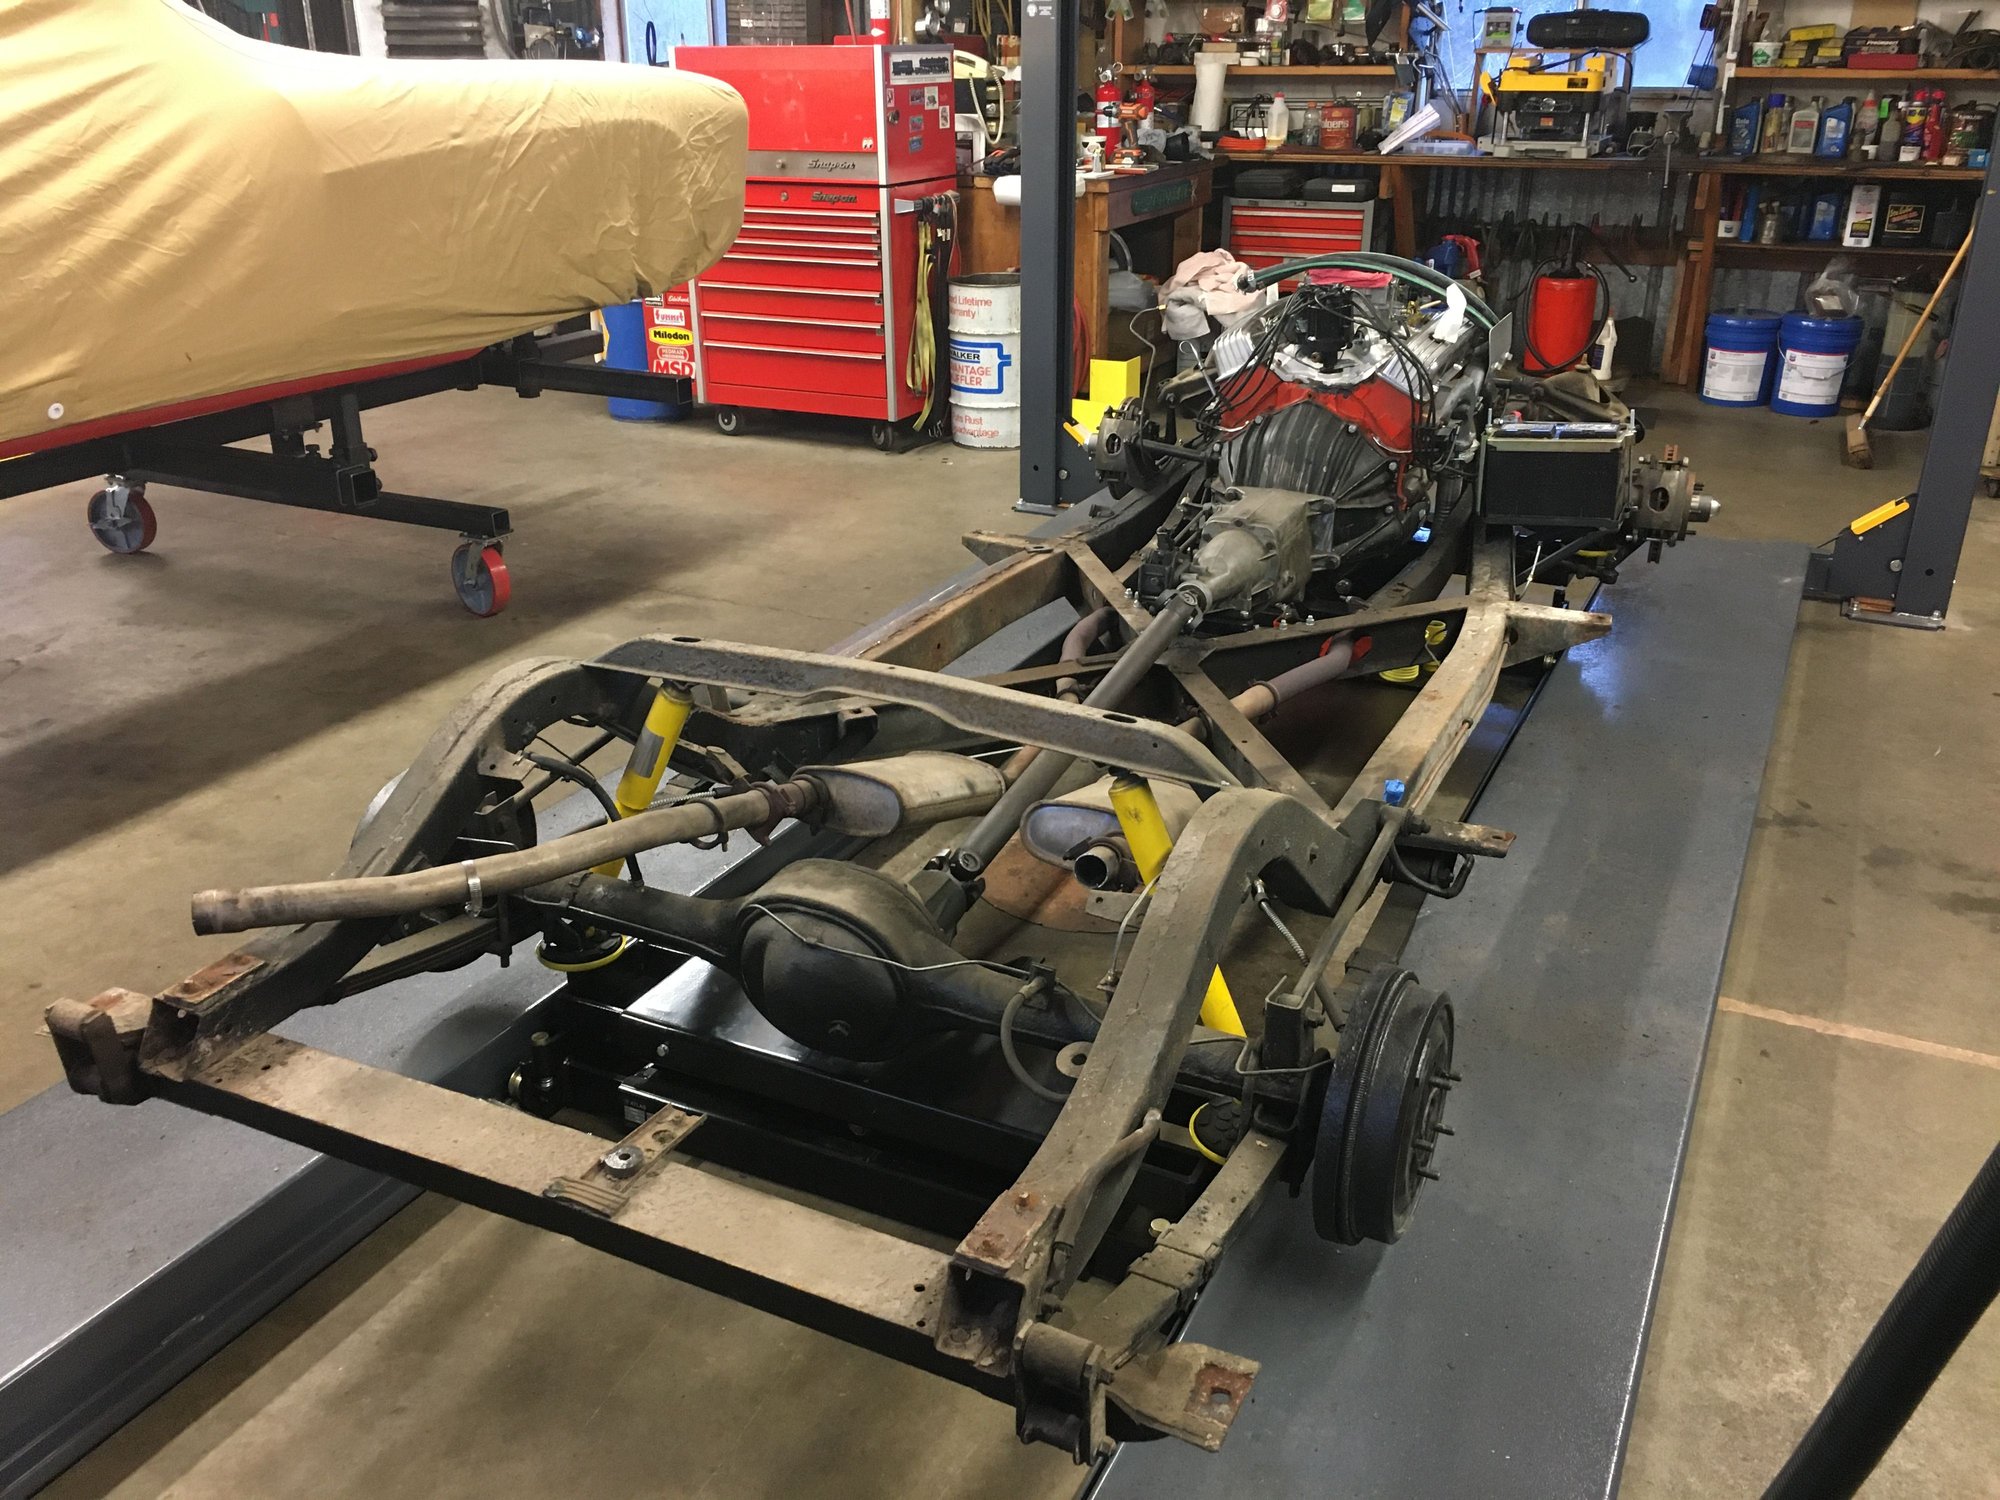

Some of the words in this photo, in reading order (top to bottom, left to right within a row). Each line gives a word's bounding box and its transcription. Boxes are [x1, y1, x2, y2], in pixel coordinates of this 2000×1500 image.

[958, 296, 993, 307] Lifetime
[653, 330, 690, 341] Milodon
[654, 361, 694, 376] MSD
[964, 414, 984, 426] Rust
